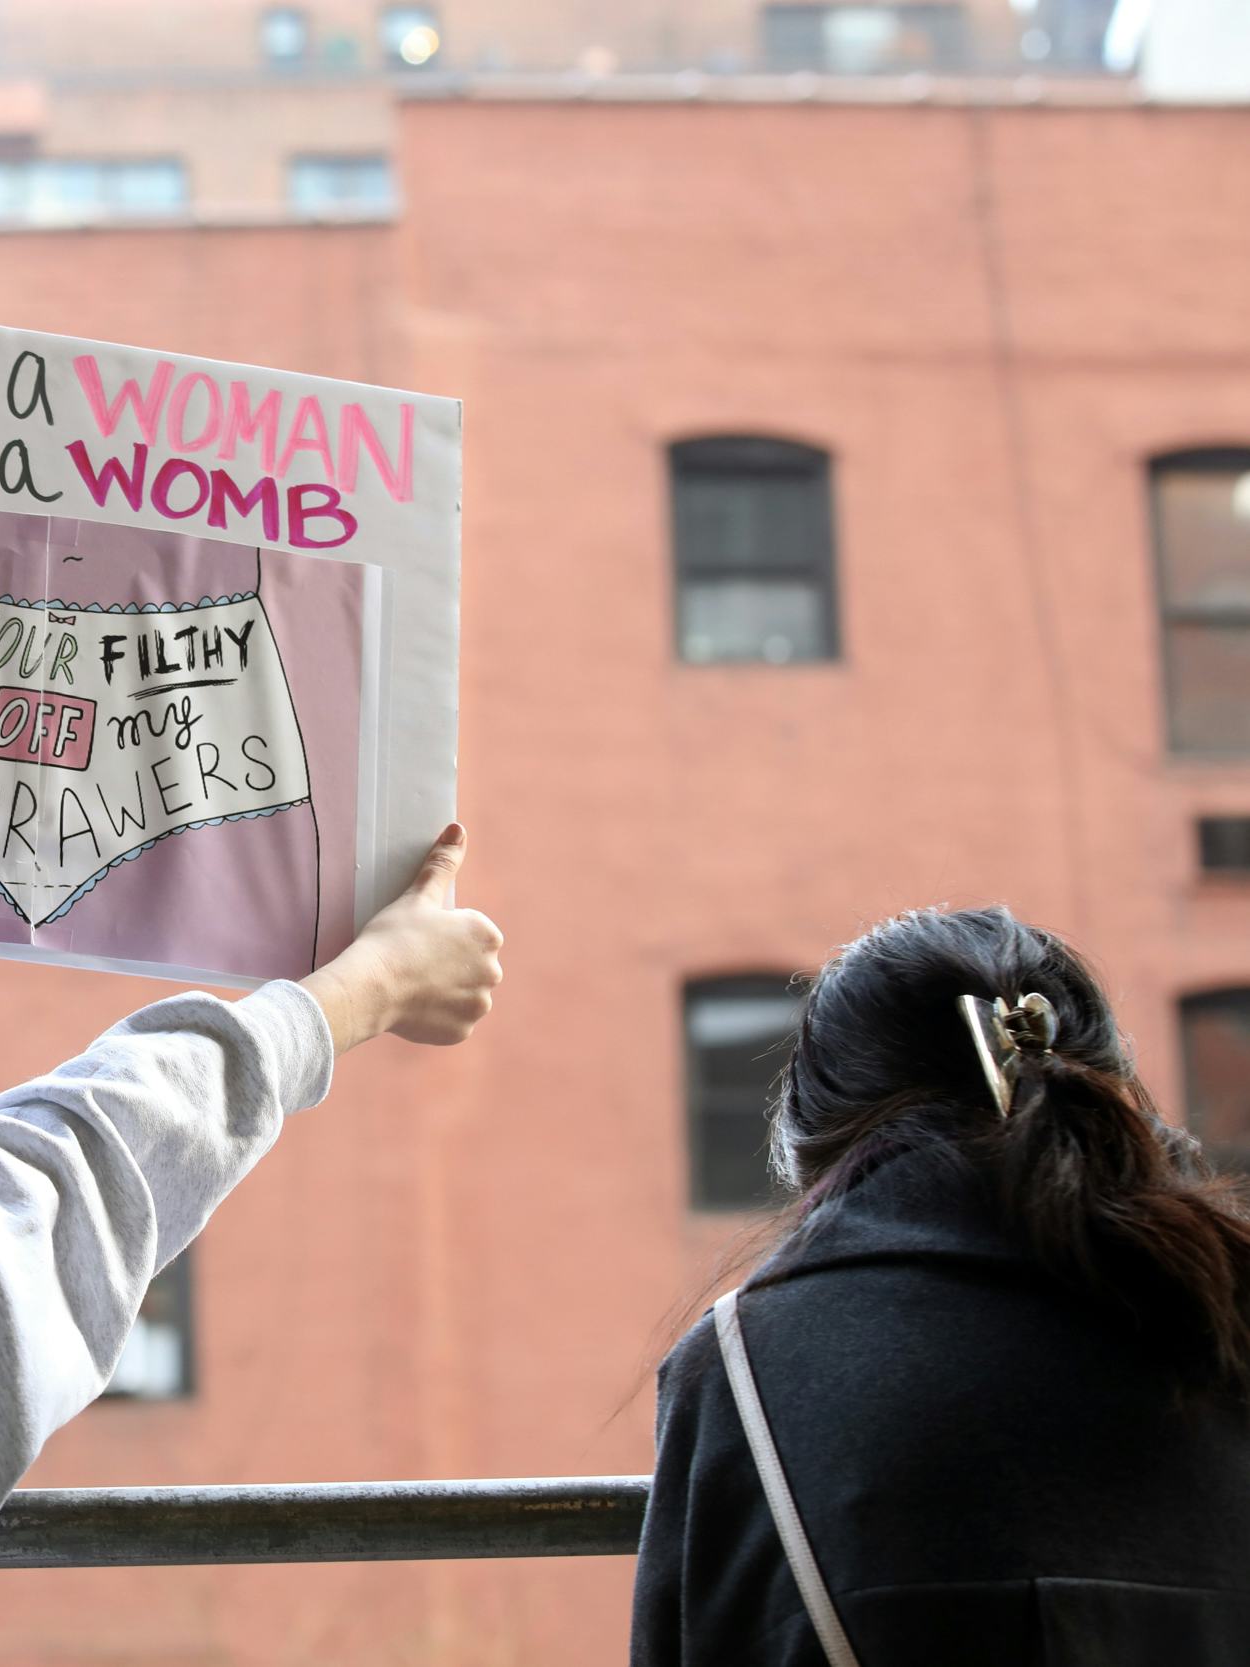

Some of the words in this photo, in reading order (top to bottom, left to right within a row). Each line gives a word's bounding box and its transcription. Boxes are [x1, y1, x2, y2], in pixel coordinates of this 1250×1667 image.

[6, 351, 55, 426] a
[72, 354, 415, 503] WOMAN
[64, 440, 359, 549] WOMB
[98, 619, 256, 686] FILTHY
[106, 695, 203, 751] my
